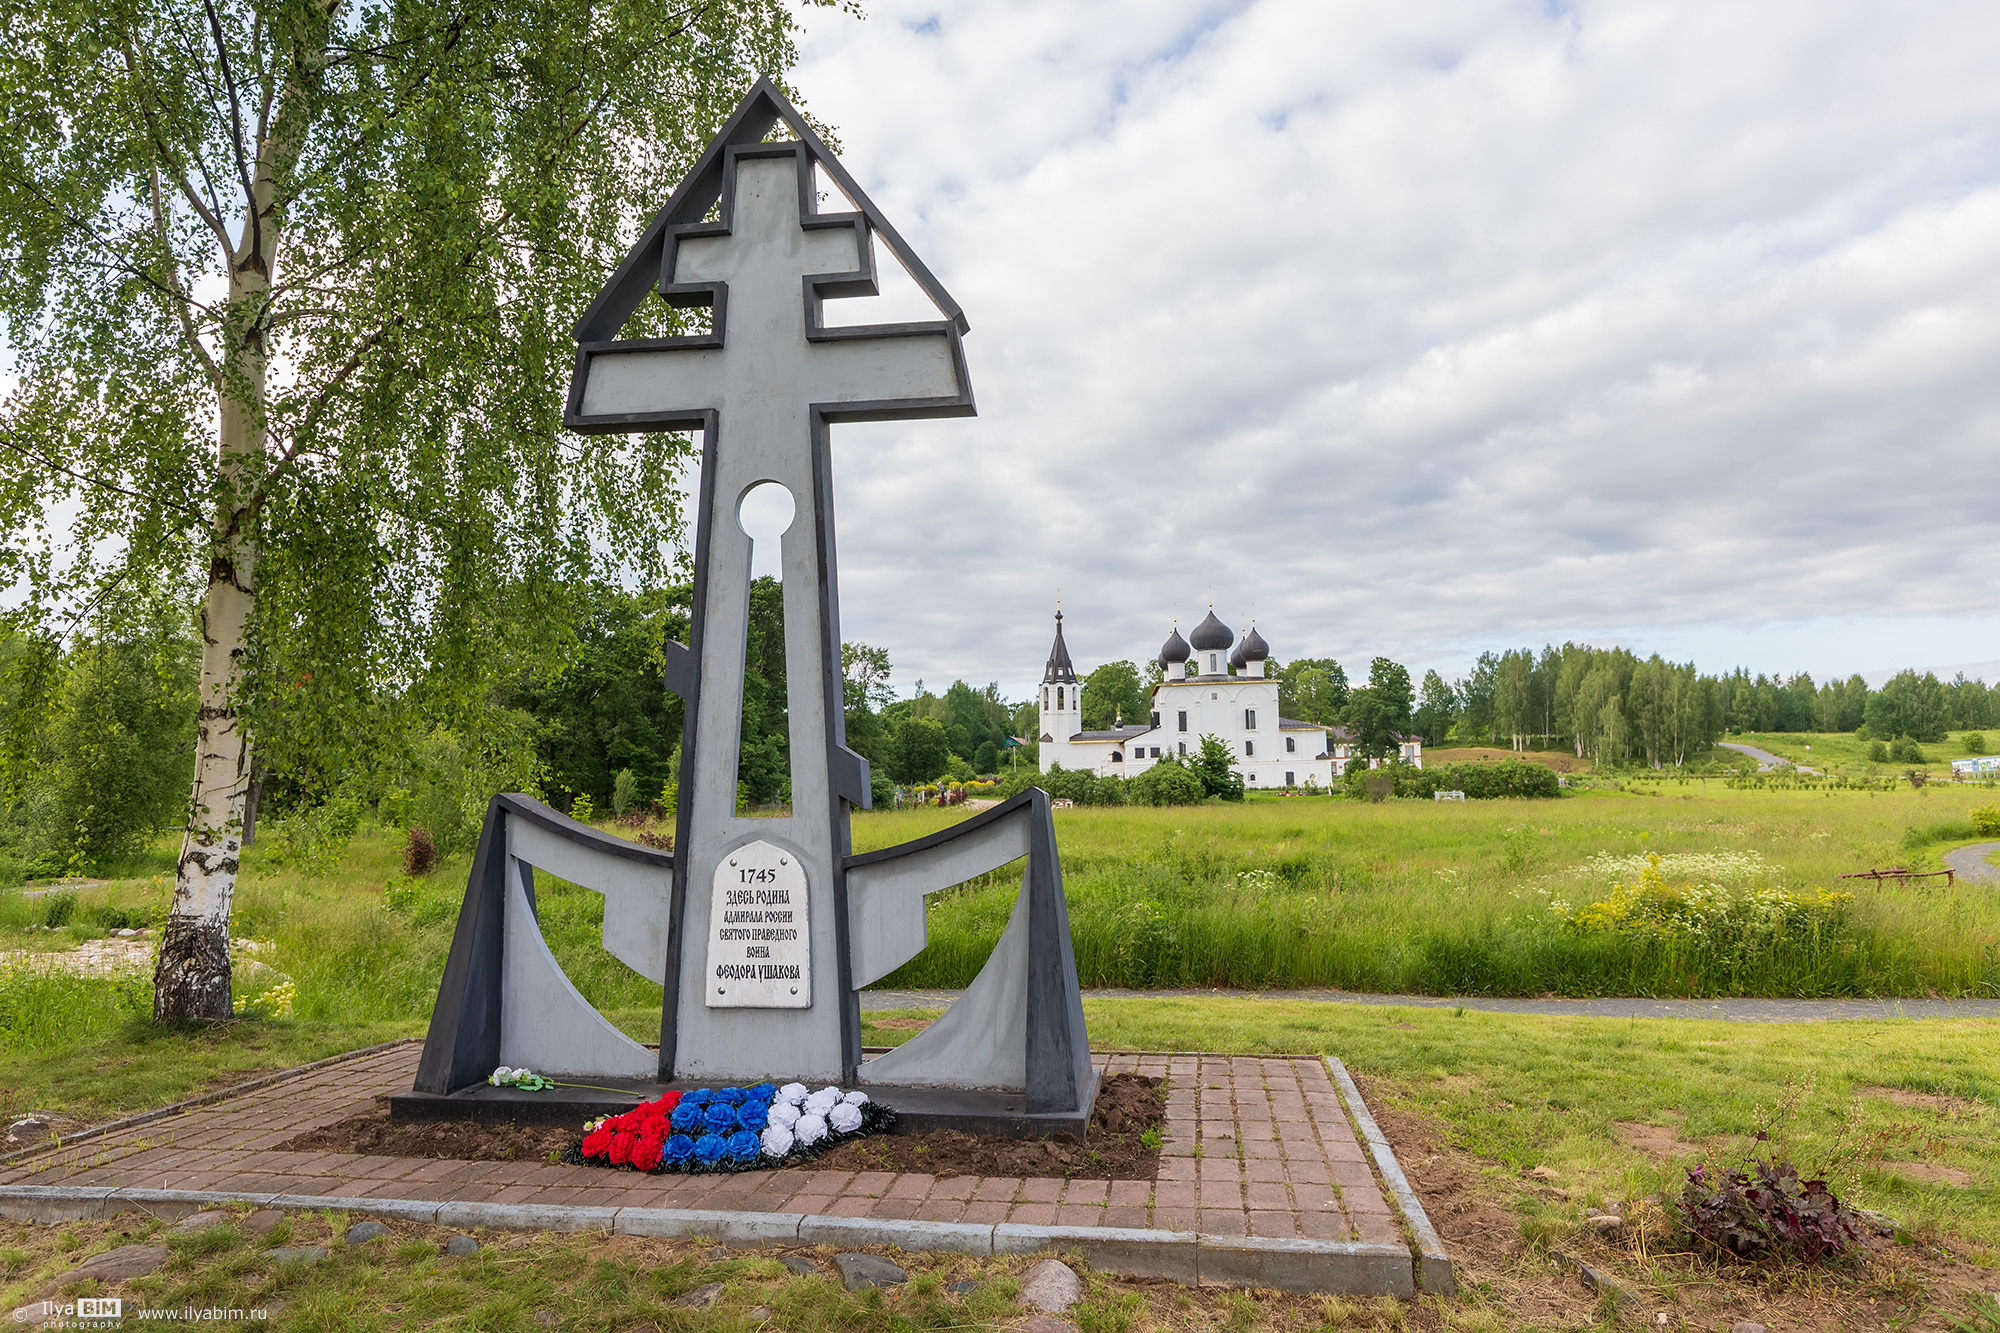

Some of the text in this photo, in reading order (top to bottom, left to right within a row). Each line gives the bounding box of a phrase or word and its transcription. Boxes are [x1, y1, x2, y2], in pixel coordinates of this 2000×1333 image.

[740, 869, 776, 883] 1745
[726, 890, 790, 906] ЗДЕСЬ РОДИНА
[724, 911, 793, 924] АДМИРАЛА РОССИИ
[719, 929, 798, 942] СВЯТОГО ПРАВЕДНОГО
[746, 946, 770, 958] ВОИНА
[716, 965, 800, 983] ФЕОДОРА УШАКОВА
